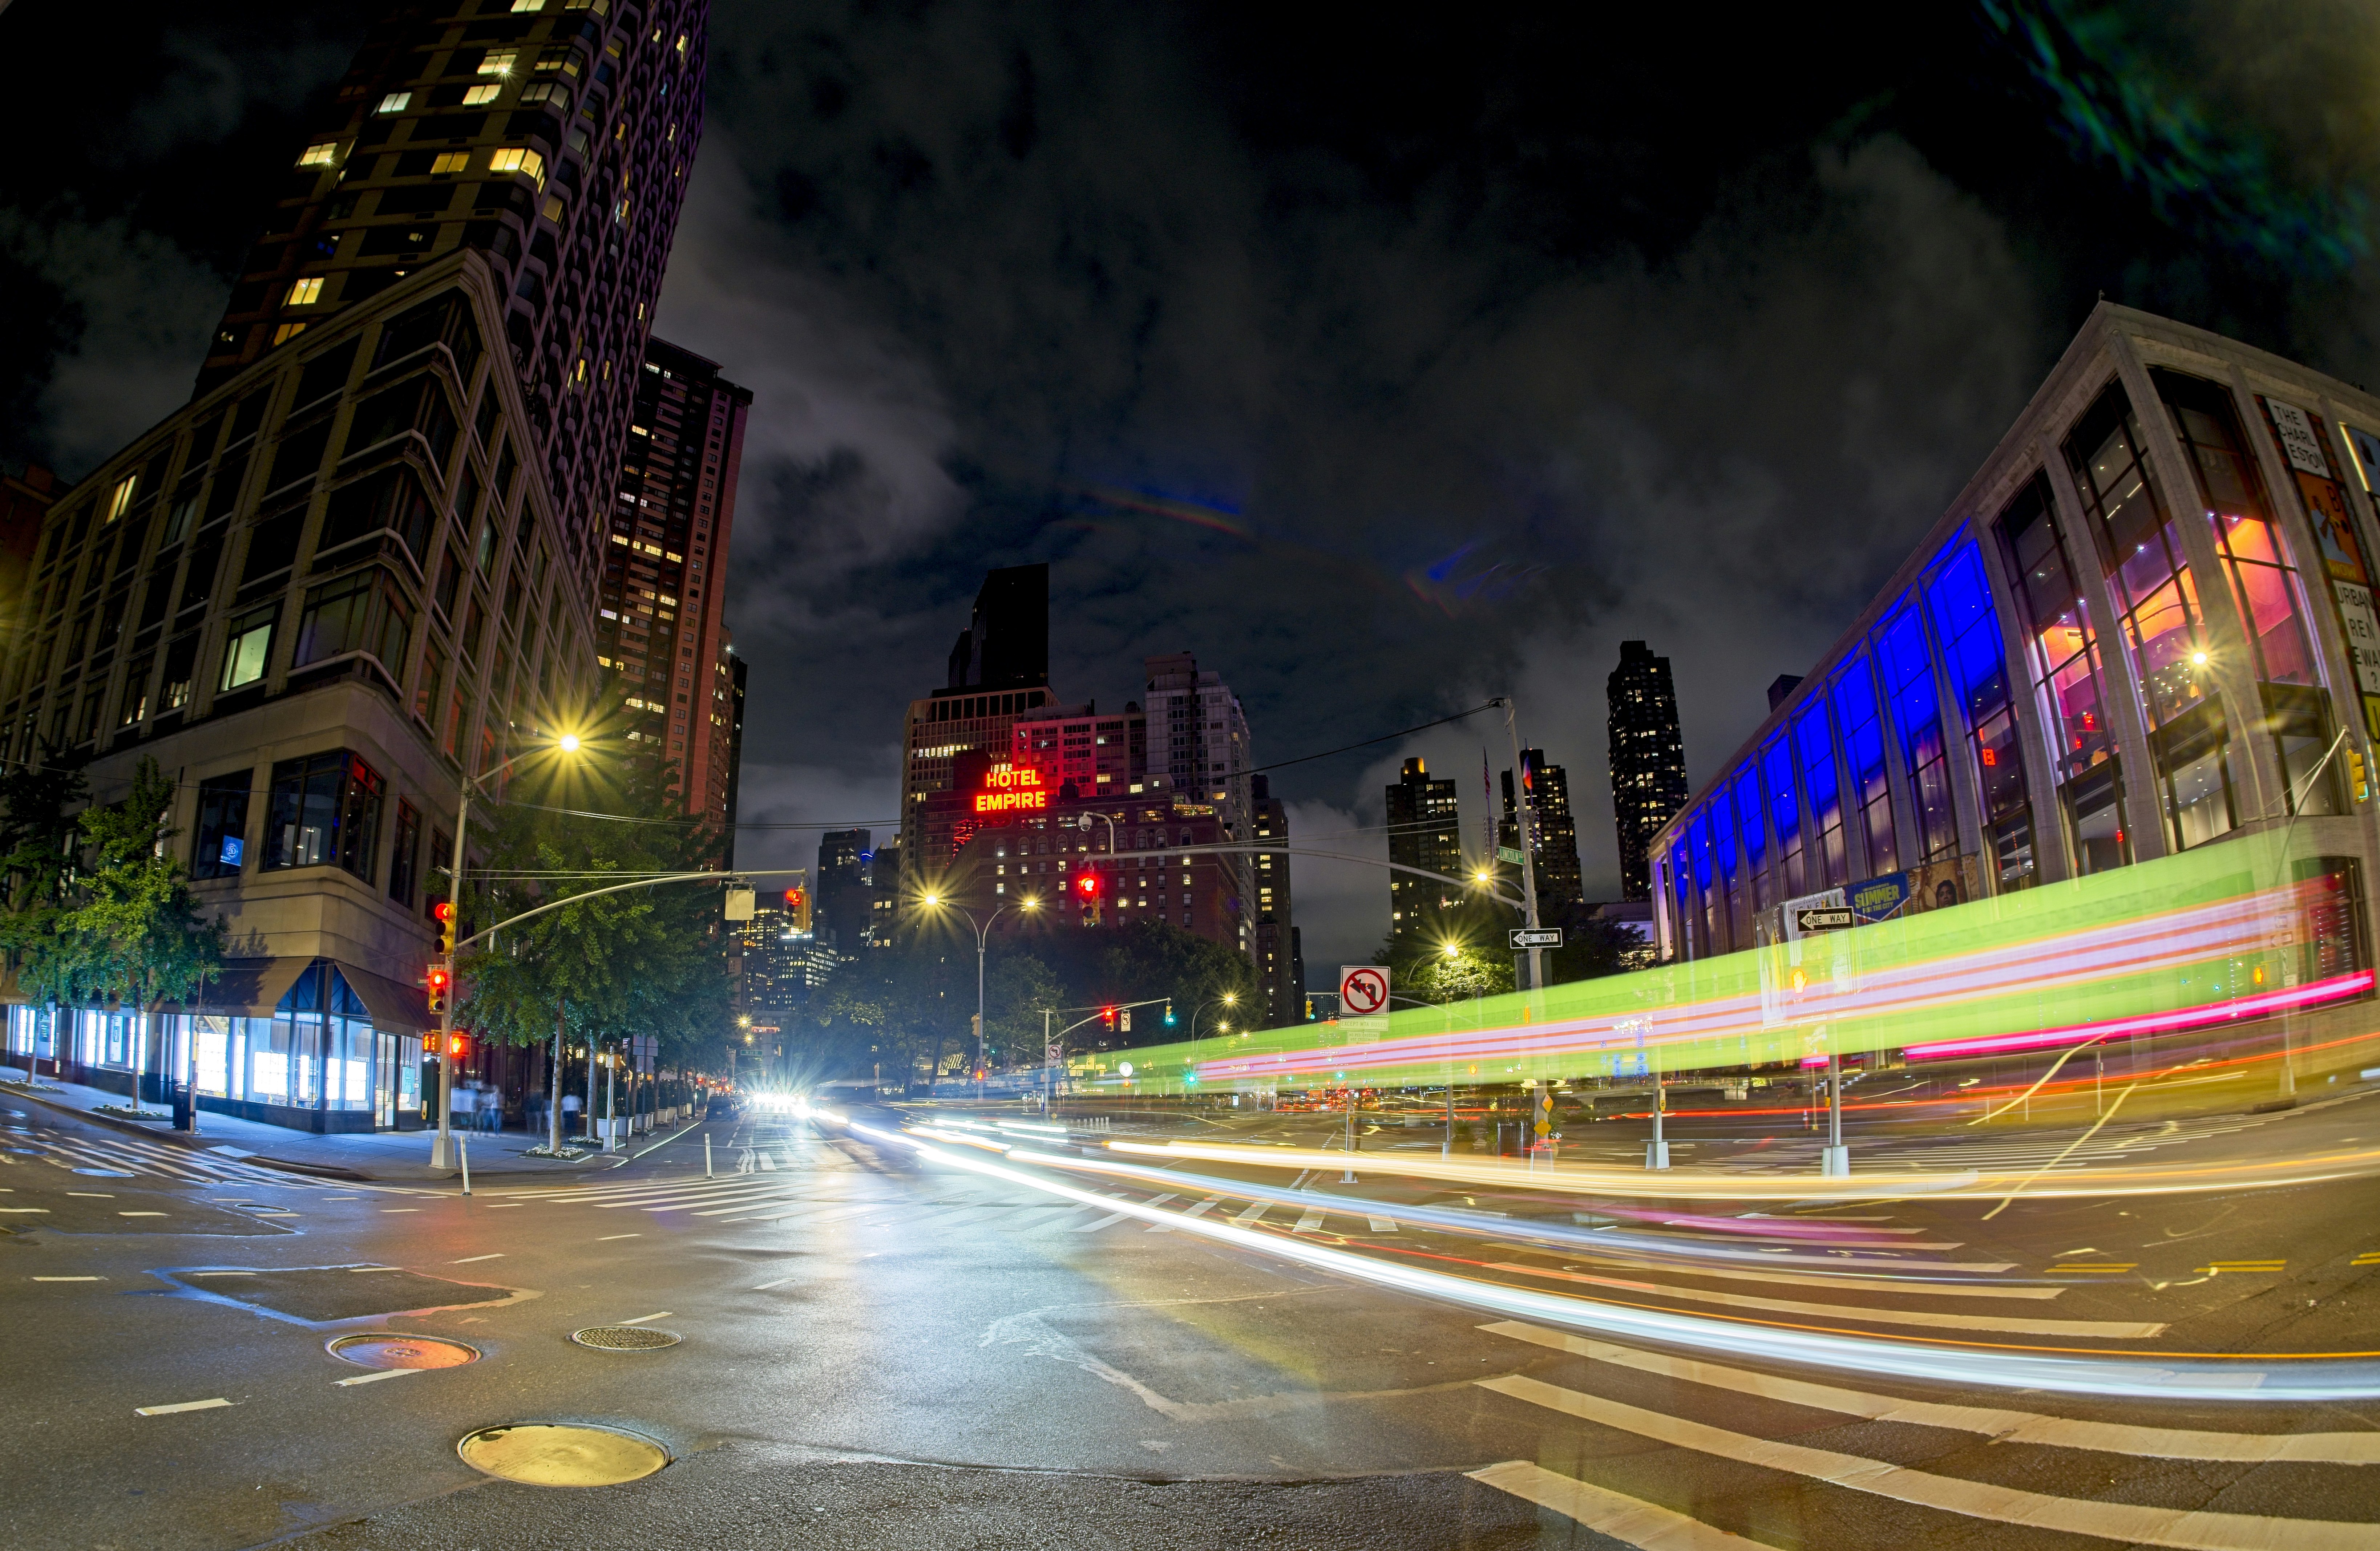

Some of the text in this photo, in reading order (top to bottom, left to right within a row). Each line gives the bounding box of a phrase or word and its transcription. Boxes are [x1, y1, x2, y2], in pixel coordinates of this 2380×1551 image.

[2274, 405, 2301, 426] THE
[987, 769, 1041, 787] HOTEL
[976, 791, 1046, 811] EMPIRE
[1500, 848, 1519, 863] LINCOLN
[1855, 884, 1900, 908] SUMMER
[1882, 901, 1894, 910] CITY
[1806, 916, 1822, 924] ONE
[1829, 914, 1846, 923] WAY
